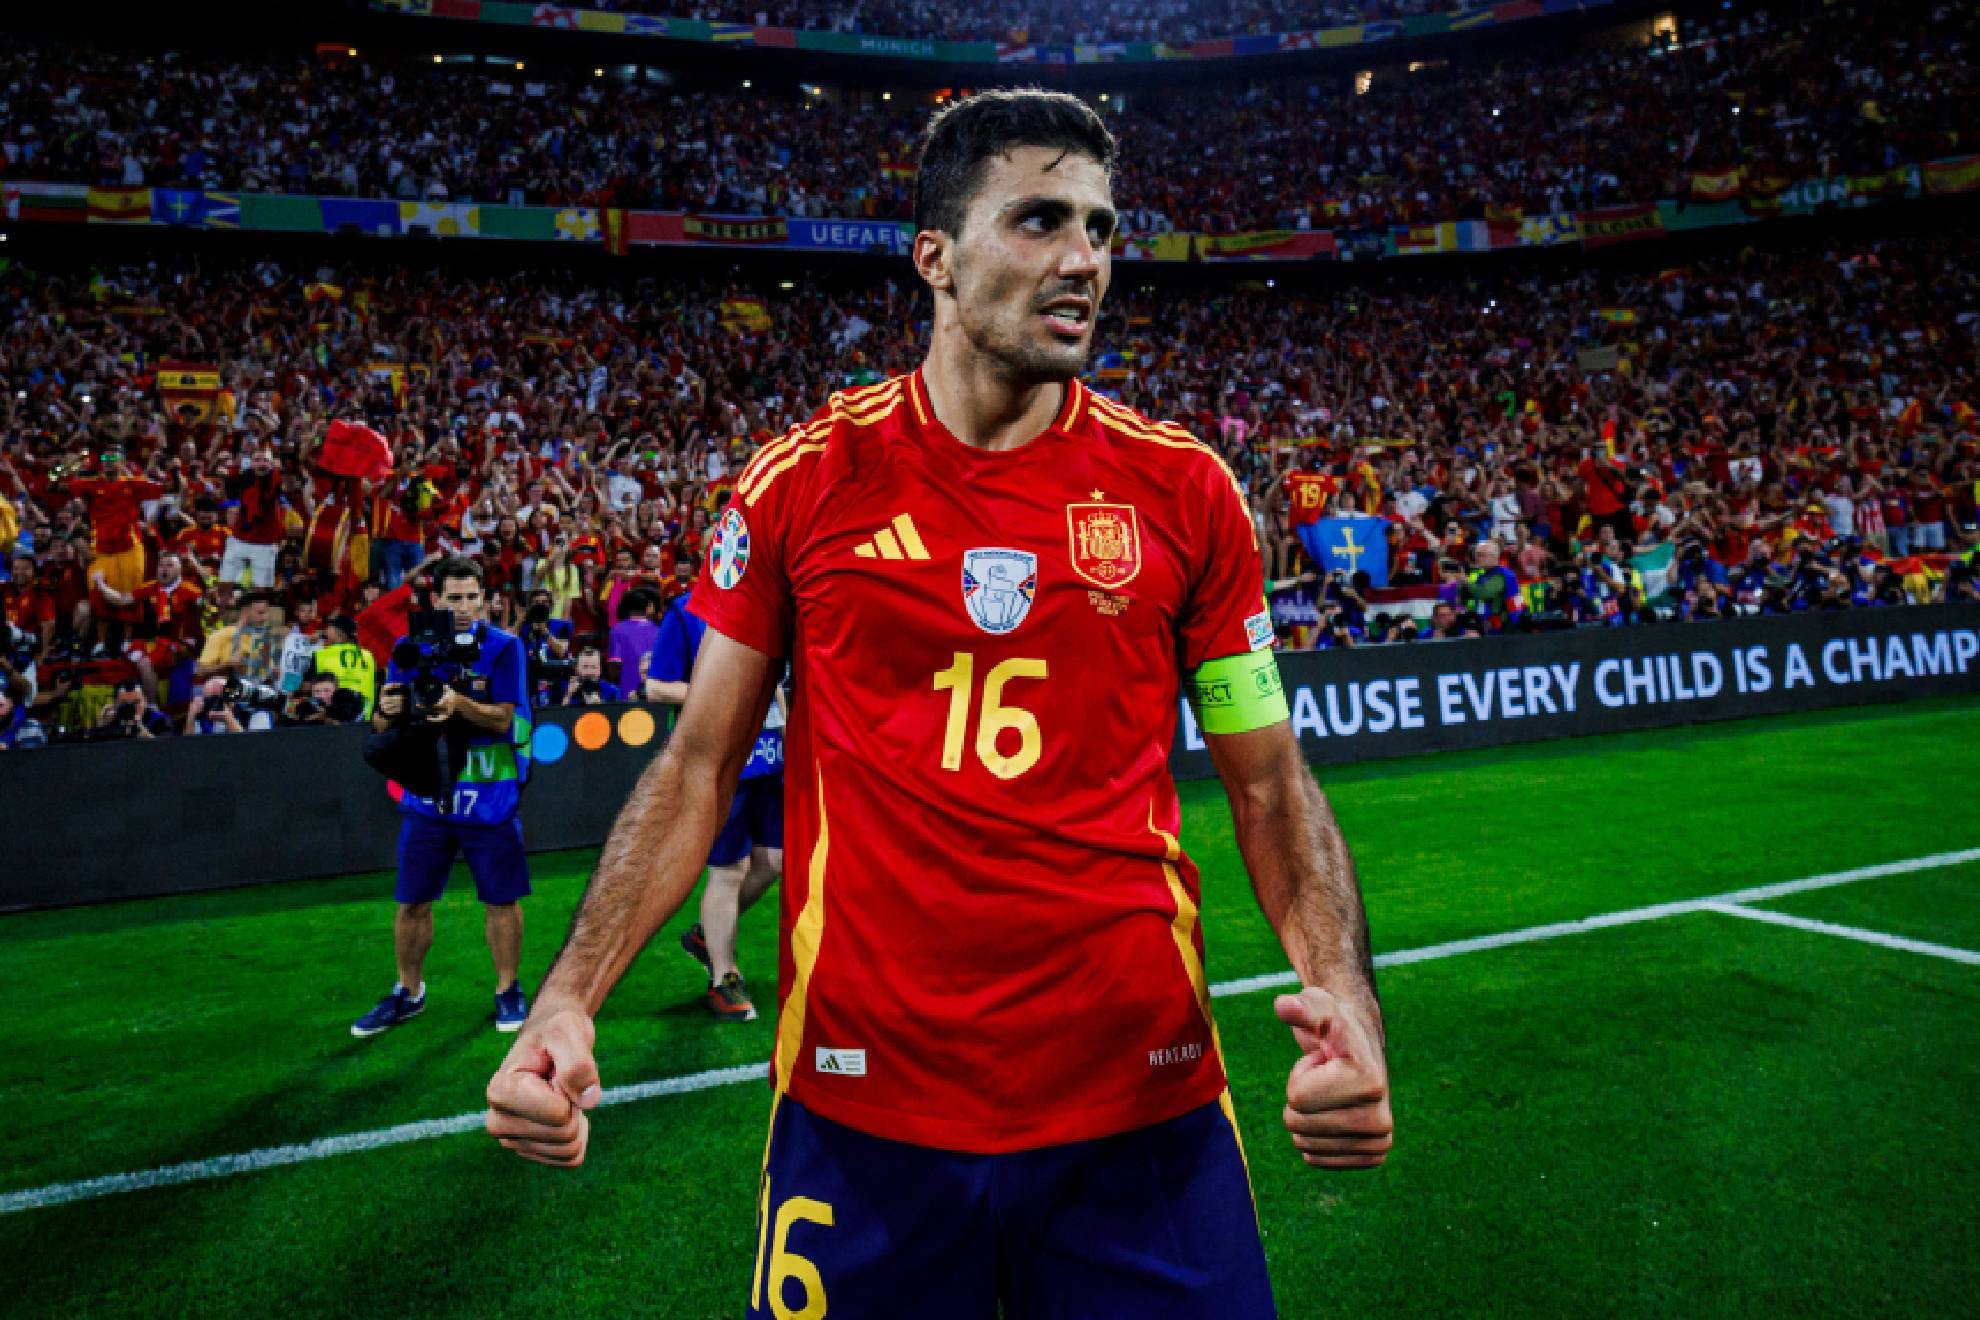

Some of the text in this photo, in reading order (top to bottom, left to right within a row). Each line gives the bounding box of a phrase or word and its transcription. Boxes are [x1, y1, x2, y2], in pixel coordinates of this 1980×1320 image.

[860, 38, 933, 57] MUNICH
[933, 650, 1047, 780] 16
[1436, 661, 1581, 726] EVERY
[1593, 650, 1724, 708] CHILD
[1731, 645, 1773, 694] IS
[1784, 643, 1816, 689] A
[1821, 629, 1980, 685] CHAMP
[751, 1173, 836, 1320] 16
